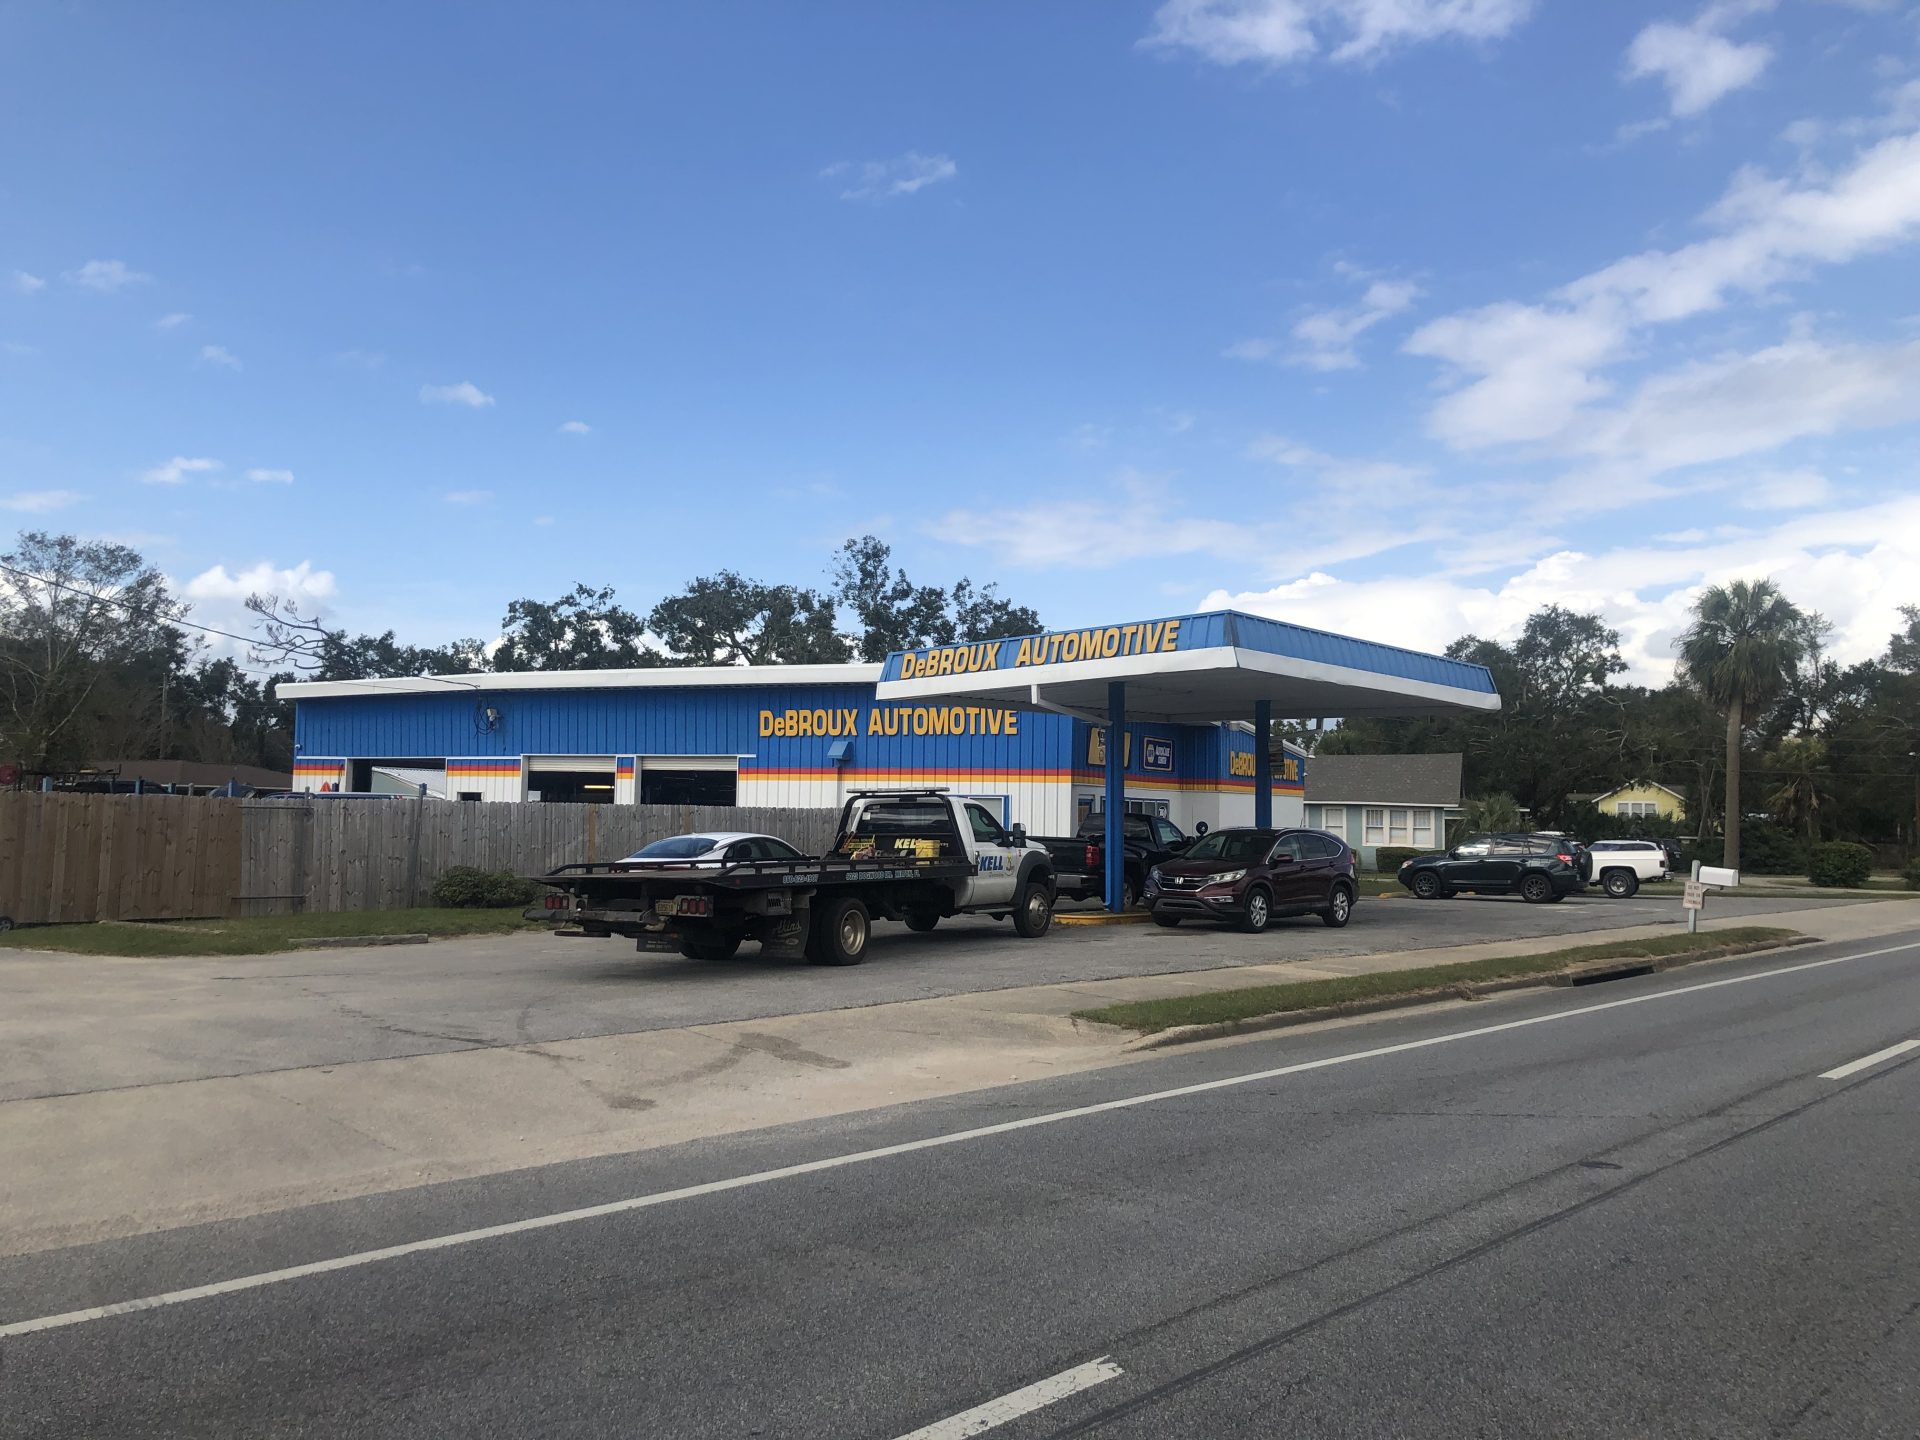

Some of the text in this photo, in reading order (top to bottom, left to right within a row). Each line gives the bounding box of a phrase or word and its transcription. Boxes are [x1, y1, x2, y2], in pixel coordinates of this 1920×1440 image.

[900, 620, 1180, 679] DeBROUX AUTOMOTIVE
[759, 707, 1018, 737] DeBROUX AUTOMOTIVE
[1230, 751, 1256, 777] DeBROU
[894, 838, 921, 849] KEL
[979, 855, 1004, 871] KELL
